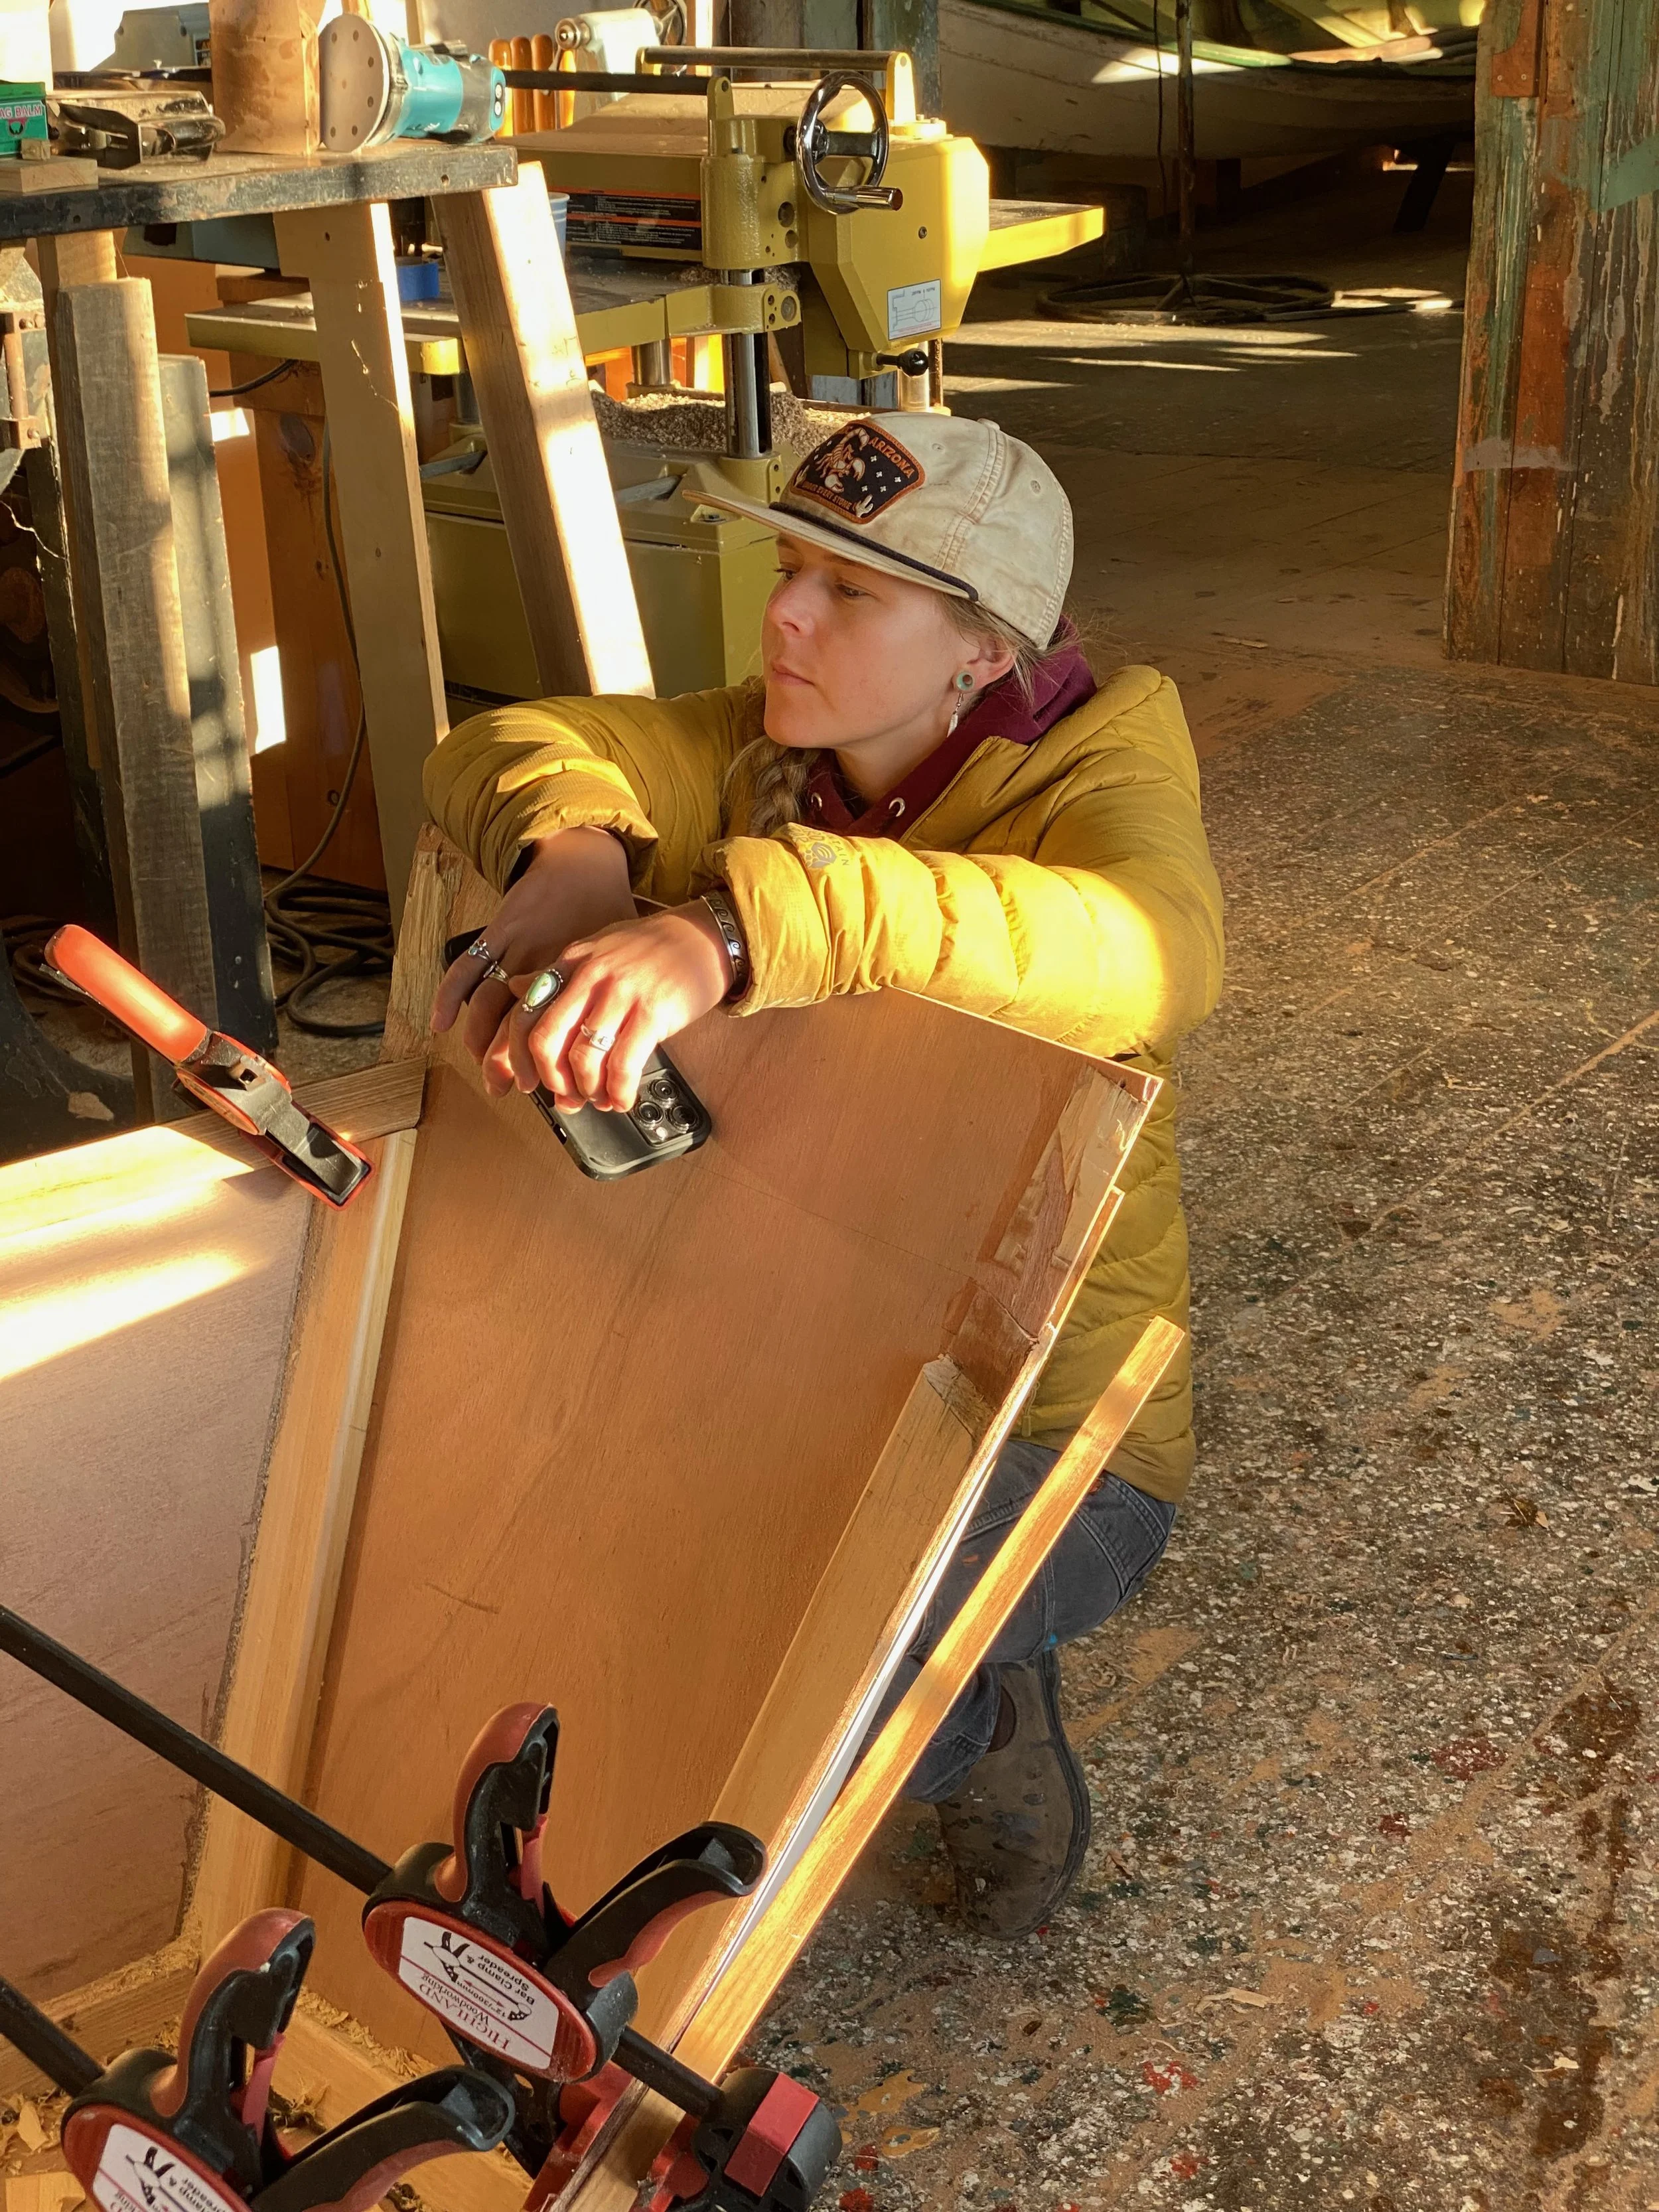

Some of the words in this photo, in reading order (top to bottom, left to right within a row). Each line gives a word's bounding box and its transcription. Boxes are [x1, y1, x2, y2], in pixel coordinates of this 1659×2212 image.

[14, 104, 43, 117] BALM
[868, 436, 916, 479] ARIZONA
[466, 1954, 475, 1964] &
[477, 1954, 530, 1992] Spreader
[477, 1962, 513, 1990] Clamp
[421, 1972, 489, 2025] Woodworking
[514, 1990, 535, 2006] Bar
[419, 1983, 510, 2051] HIGHLAND
